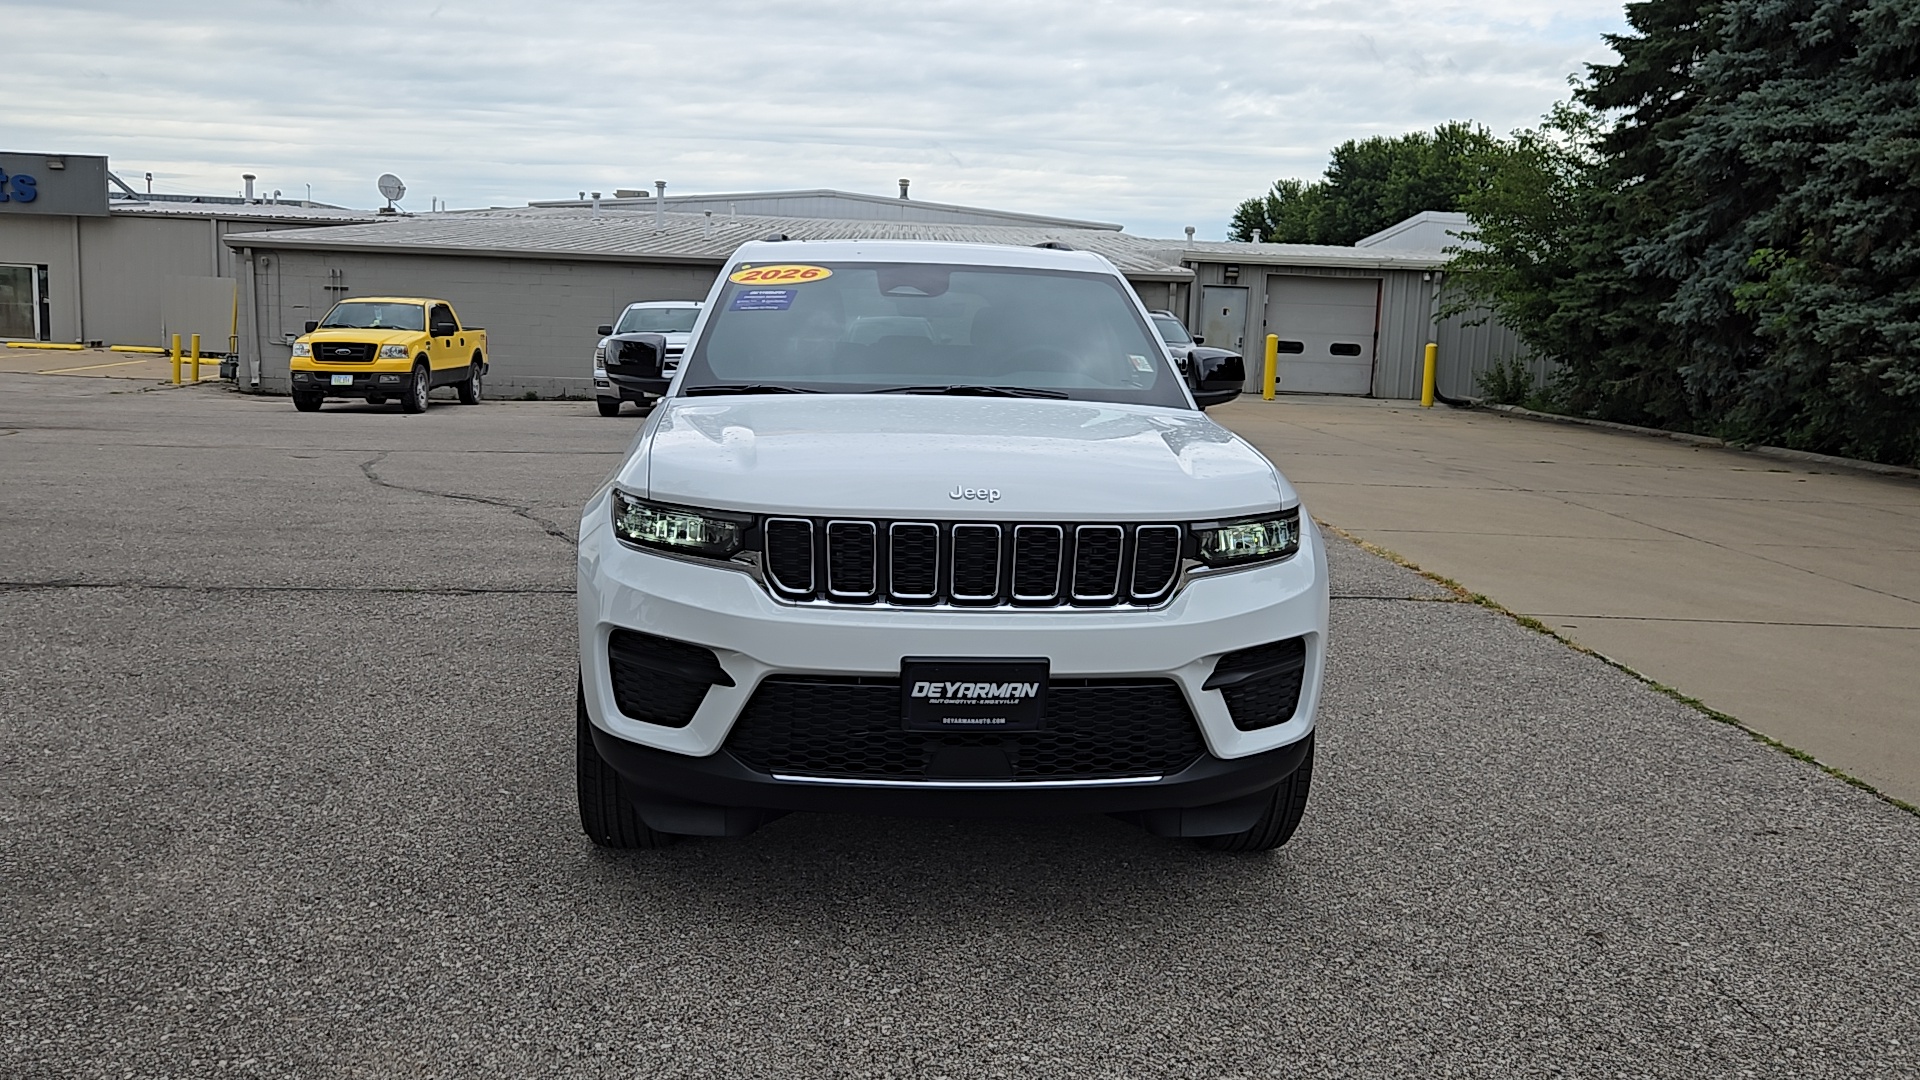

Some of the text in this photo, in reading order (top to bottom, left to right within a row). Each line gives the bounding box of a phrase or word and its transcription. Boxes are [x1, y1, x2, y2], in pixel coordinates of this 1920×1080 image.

[739, 269, 821, 281] 2026
[949, 485, 1001, 503] Jeep
[911, 682, 1040, 698] DEYARMAN
[942, 717, 1006, 725] DEYARMANAUTO.COM
